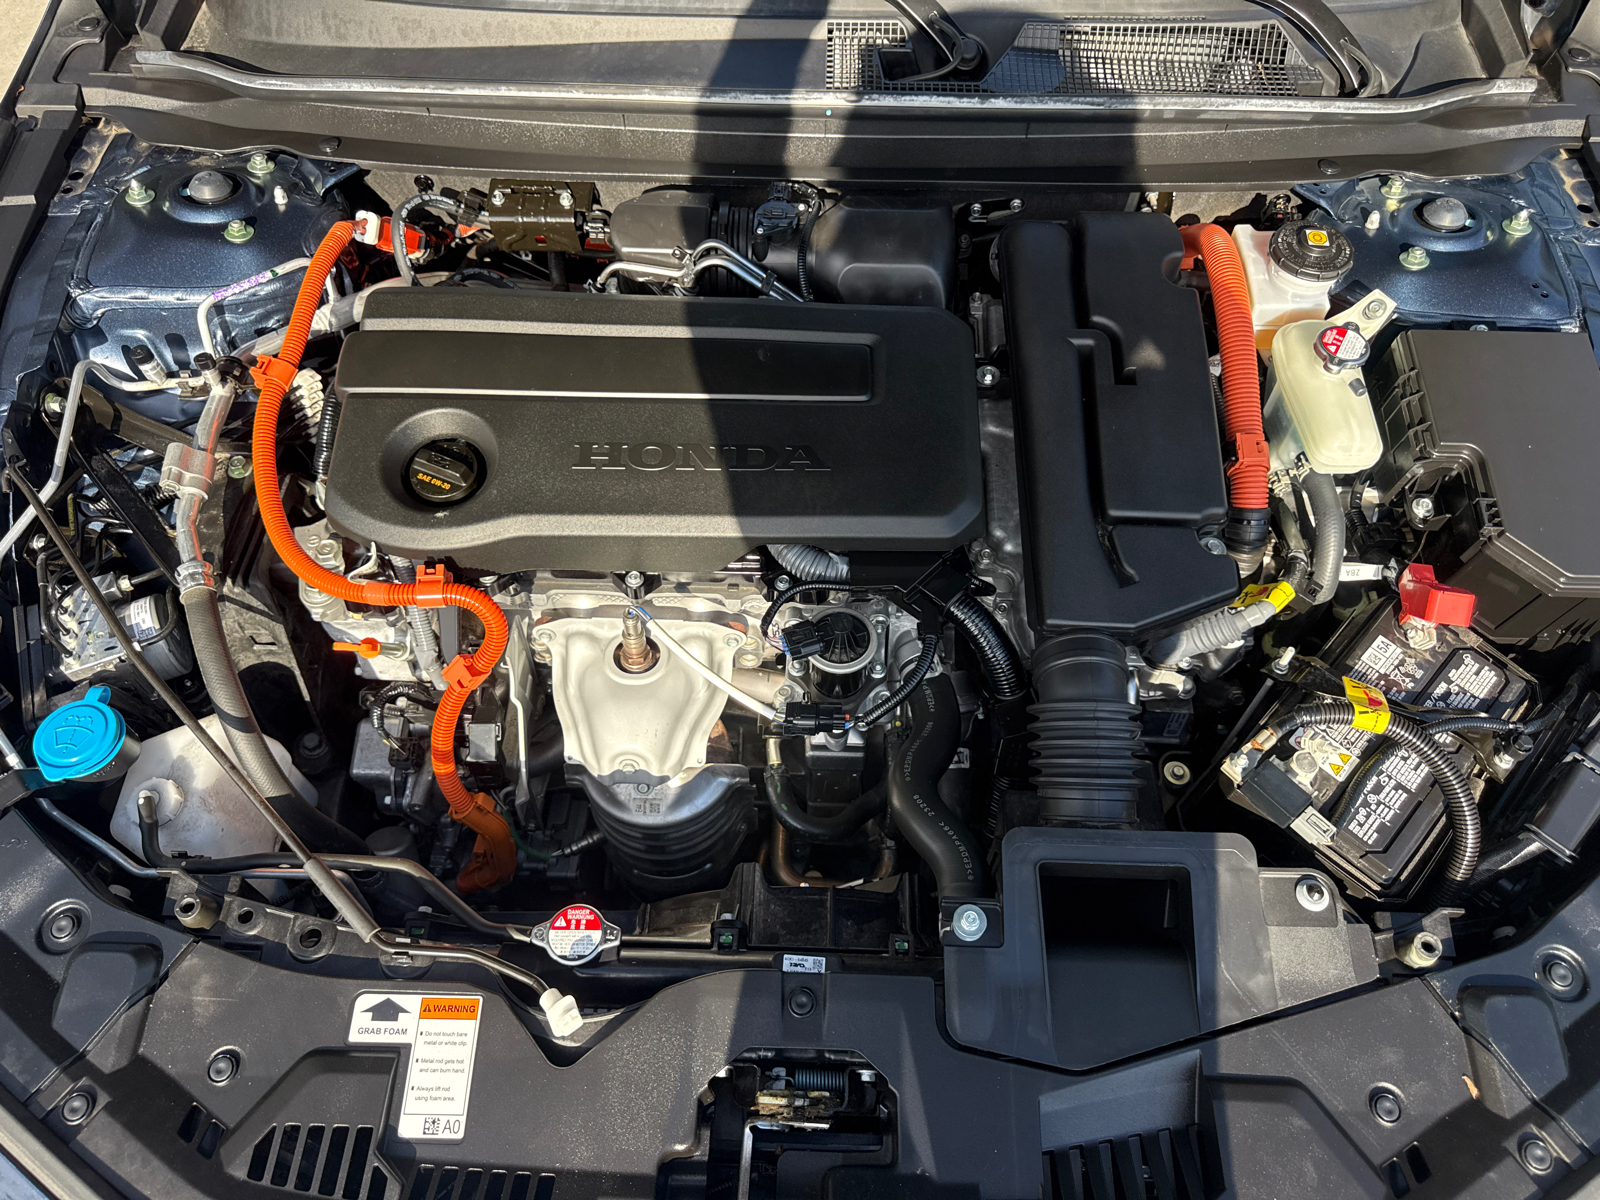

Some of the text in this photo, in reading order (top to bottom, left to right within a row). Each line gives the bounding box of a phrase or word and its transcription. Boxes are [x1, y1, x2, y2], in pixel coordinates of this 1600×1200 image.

[571, 441, 832, 472] HONDA
[417, 472, 451, 490] SAE 0W-20
[1376, 639, 1392, 654] 5A
[912, 792, 935, 817] 23208
[433, 1004, 476, 1013] WARNING
[357, 1027, 408, 1035] GRAB FOAM
[416, 1085, 434, 1093] Always
[442, 1119, 461, 1134] A0
